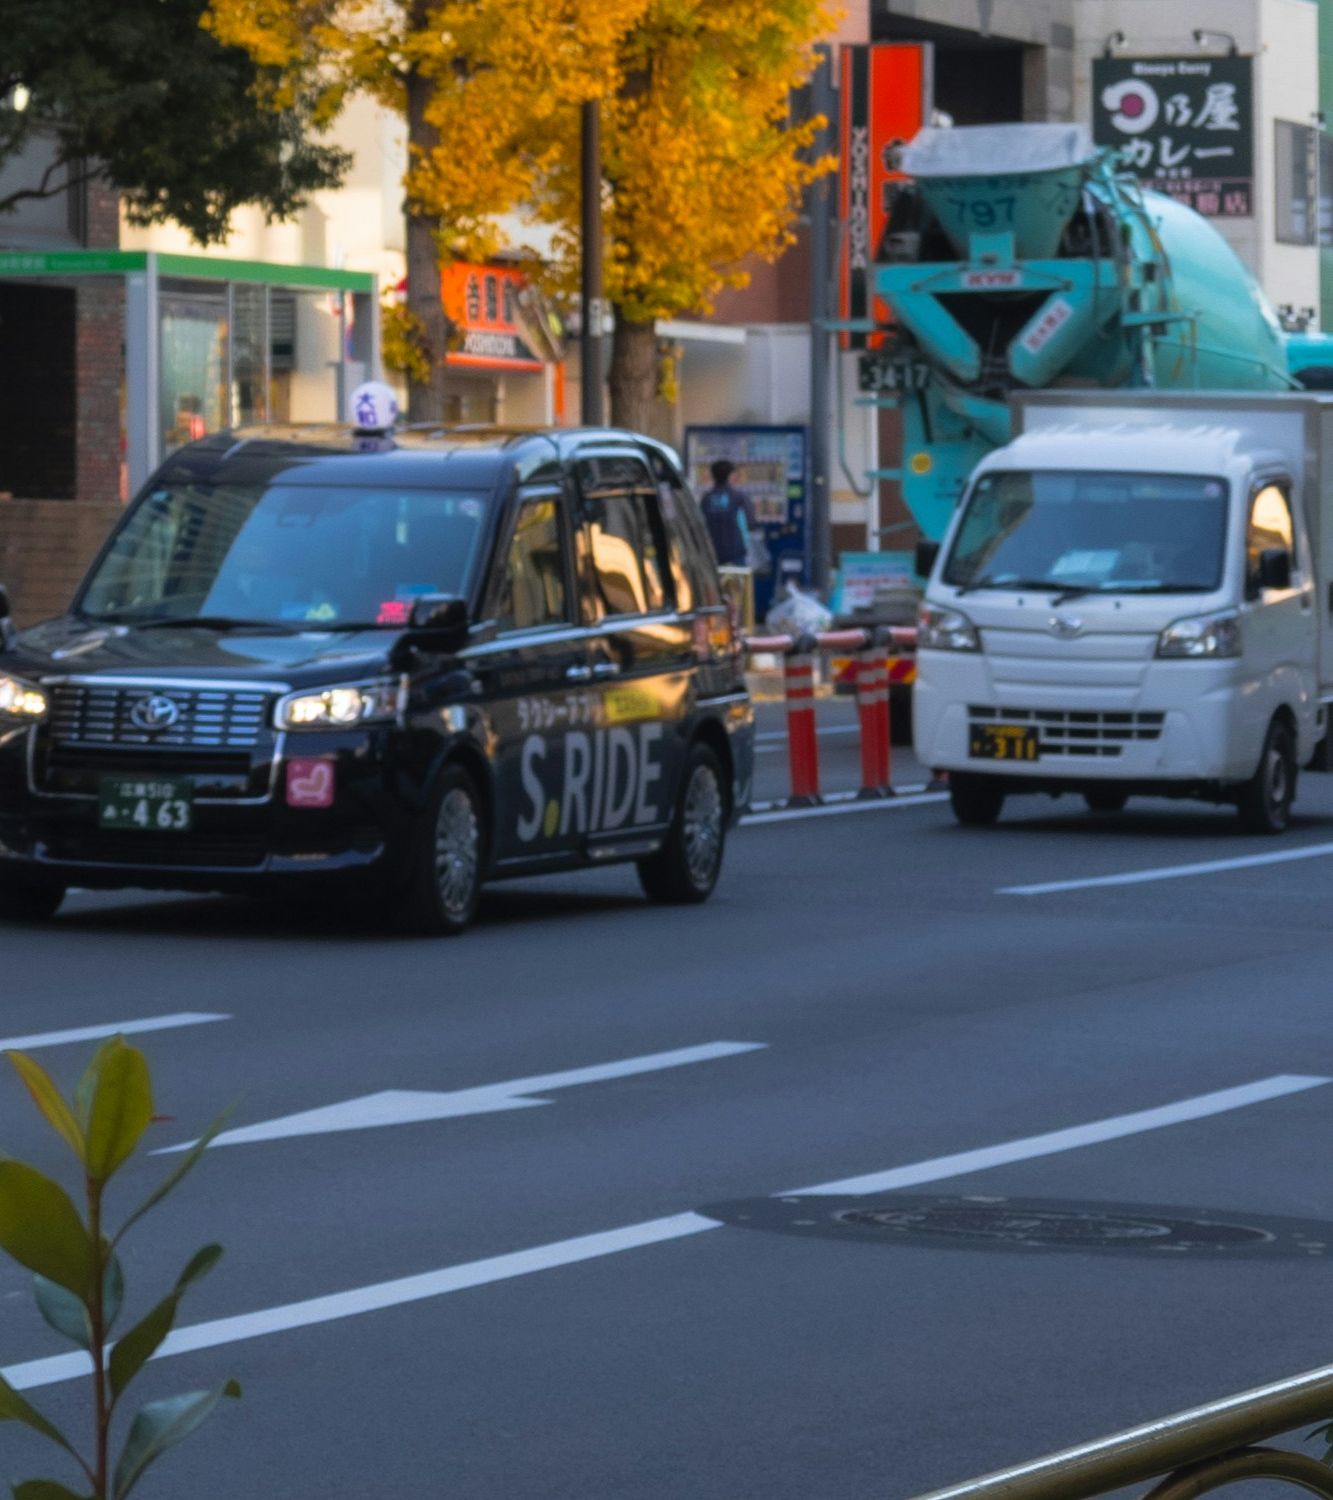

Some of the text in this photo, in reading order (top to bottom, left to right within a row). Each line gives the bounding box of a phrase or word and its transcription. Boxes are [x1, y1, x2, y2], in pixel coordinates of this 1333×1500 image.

[1121, 136, 1234, 169] カレー
[948, 196, 1017, 228] 797
[516, 720, 663, 843] S.RIDE
